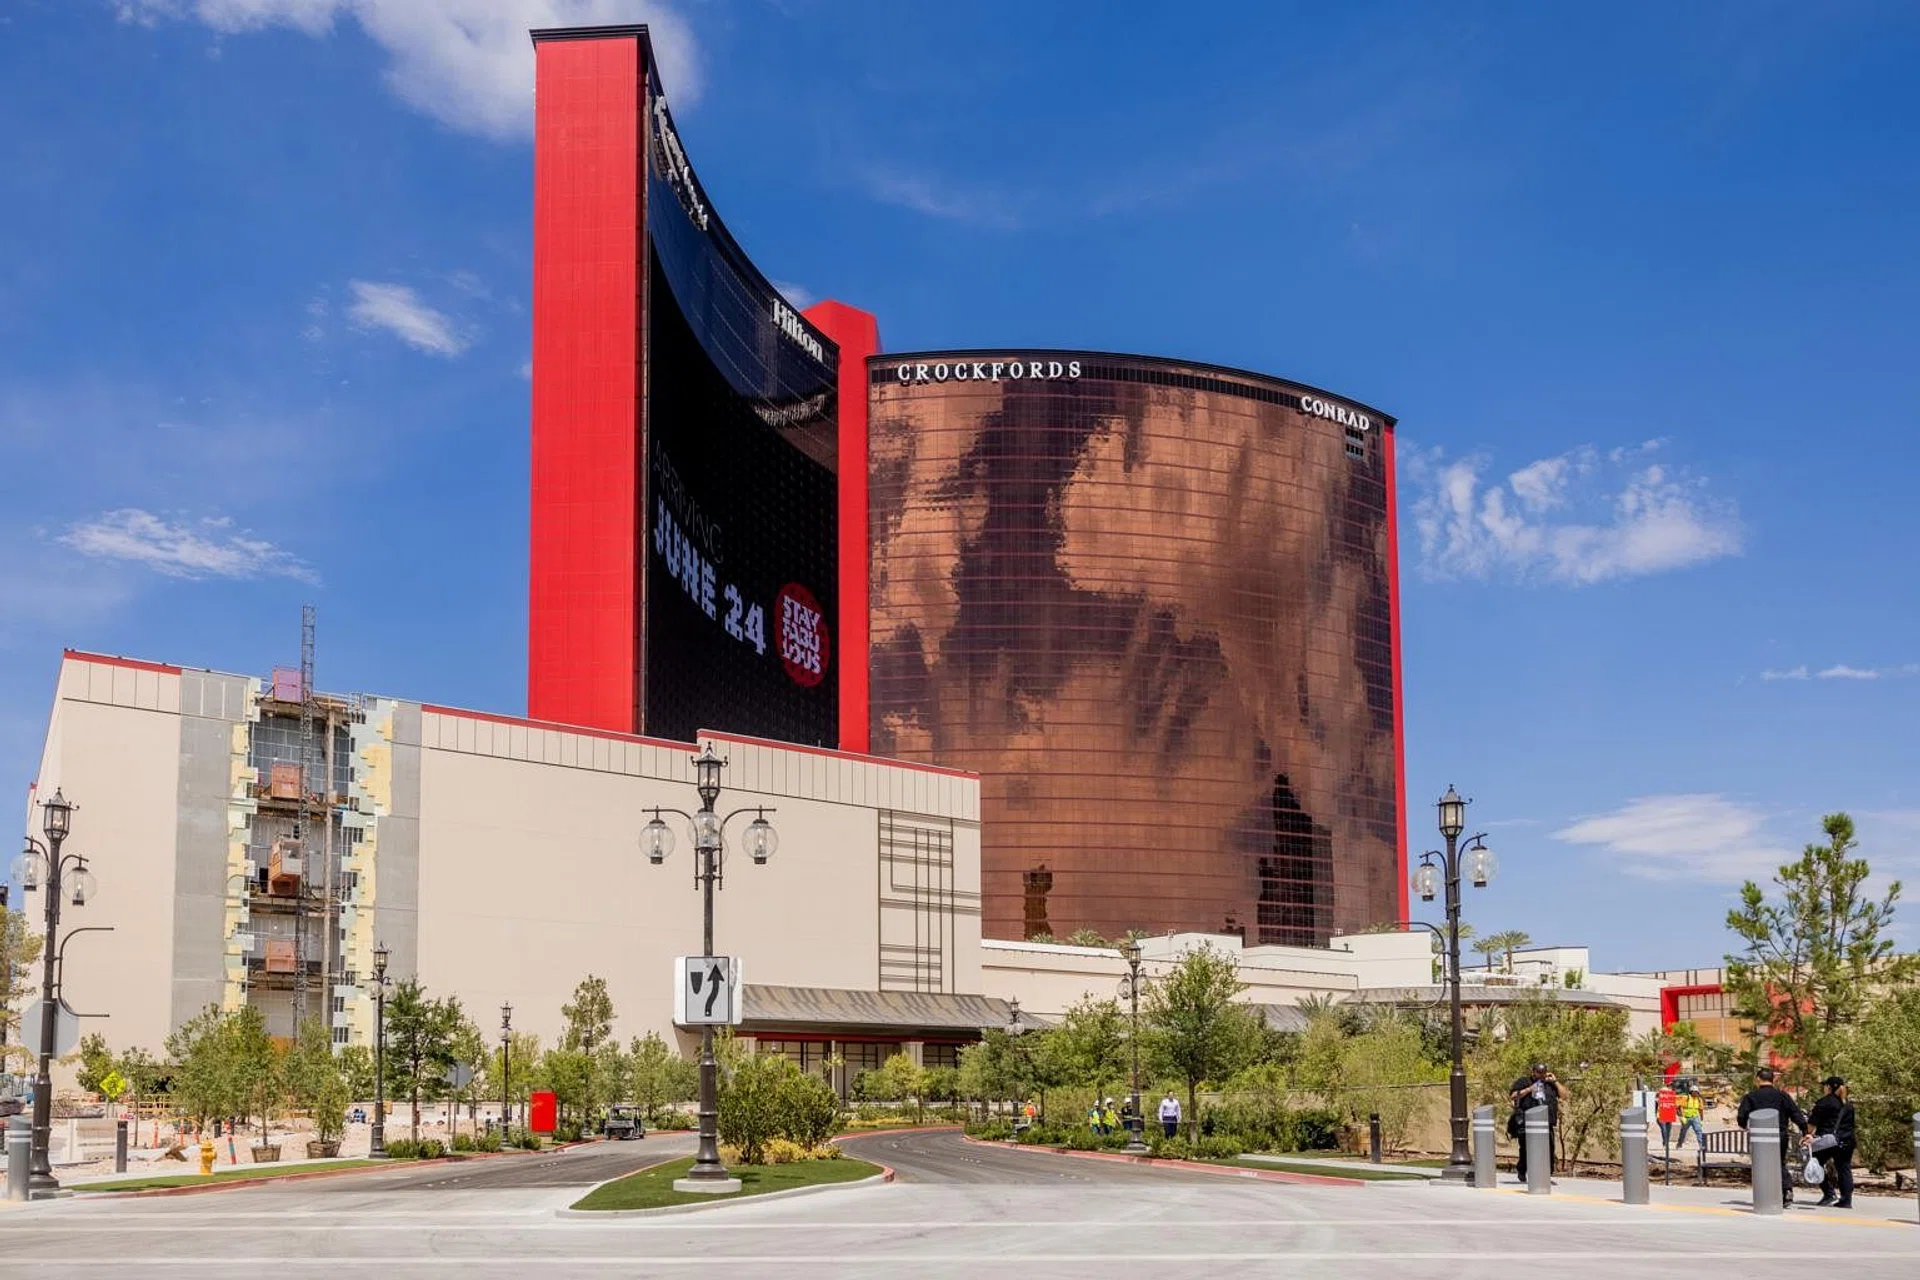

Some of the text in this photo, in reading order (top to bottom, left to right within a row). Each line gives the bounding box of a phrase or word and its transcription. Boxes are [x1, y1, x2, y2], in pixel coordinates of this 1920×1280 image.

[773, 298, 823, 363] Hilton
[897, 361, 1081, 382] CROCKFORDS
[1301, 396, 1370, 431] CONRAD
[653, 494, 767, 656] JUNE 24
[783, 595, 821, 633] STAY
[782, 638, 821, 674] LOUS
